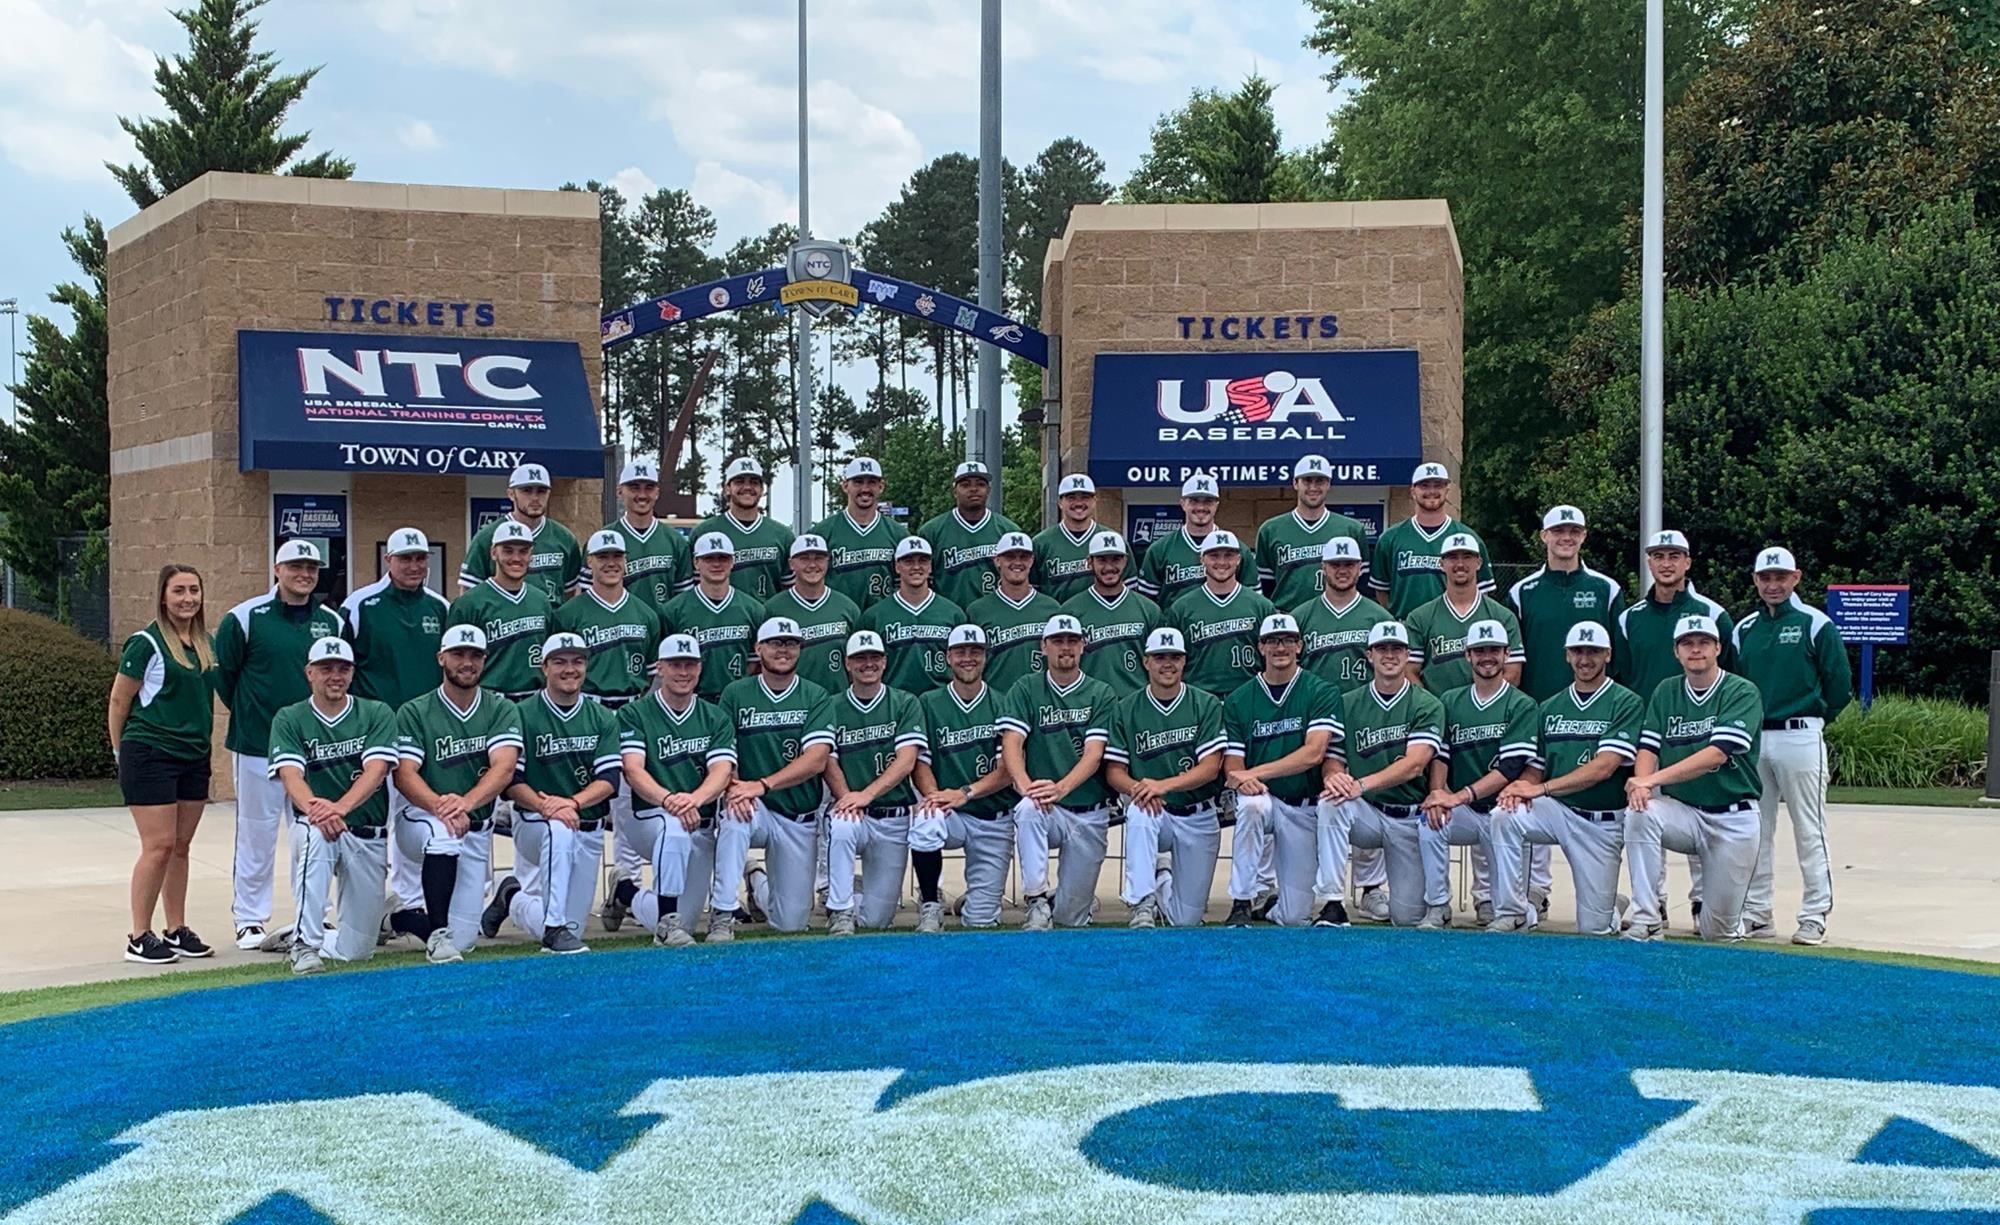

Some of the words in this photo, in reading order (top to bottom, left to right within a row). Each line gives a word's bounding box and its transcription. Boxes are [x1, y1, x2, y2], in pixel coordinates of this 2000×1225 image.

[807, 260, 831, 269] NTC
[325, 298, 495, 327] TICKETS
[1178, 315, 1339, 340] TICKETS
[297, 347, 543, 401] NTC
[1157, 371, 1346, 423] USA
[304, 399, 332, 407] USA
[335, 401, 405, 409] BASEBALL
[304, 407, 388, 417] NATIONAL
[390, 409, 466, 420] TRAINING
[470, 412, 545, 422] COMPLEX
[1158, 426, 1346, 442] BASEBALL
[741, 462, 753, 470] M
[860, 462, 872, 472] M
[967, 464, 979, 473] M
[1310, 460, 1321, 470] M
[528, 469, 542, 480] M
[635, 466, 648, 476] M
[1128, 466, 1171, 481] OUR
[1426, 467, 1438, 475] M
[1073, 478, 1085, 488] M
[1197, 480, 1209, 491] M
[1561, 510, 1574, 520] M
[509, 526, 522, 536] M
[405, 534, 420, 545] M
[602, 534, 616, 545] M
[710, 539, 723, 549] M
[805, 538, 818, 547] M
[1011, 536, 1024, 546] M
[1103, 536, 1116, 547] M
[1216, 535, 1229, 544] M
[1453, 537, 1465, 546] M
[1661, 534, 1672, 543] M
[297, 545, 311, 555] M
[909, 540, 922, 549] M
[1336, 544, 1349, 554] M
[530, 553, 564, 567] HURST
[832, 547, 894, 567] MERCYHURST
[944, 544, 999, 569] MERCYHURS
[1277, 544, 1324, 565] MERCYHU
[1767, 554, 1779, 565] M
[625, 555, 672, 575] ERCYHURST
[982, 572, 996, 592] 2
[778, 622, 792, 633] M
[1059, 619, 1072, 629] M
[1273, 618, 1286, 629] M
[1689, 619, 1701, 629] M
[487, 616, 545, 643] MERCYHURST
[801, 622, 847, 640] RCYHURST
[886, 623, 951, 643] MERCYHURST
[1082, 623, 1144, 645] MERCYHURST
[1190, 617, 1256, 642] MERCYHURST
[1383, 626, 1396, 636] M
[1480, 627, 1493, 638] M
[1579, 629, 1593, 641] M
[461, 631, 474, 642] M
[583, 625, 647, 646] MERCYHURST
[860, 635, 873, 646] M
[964, 630, 977, 641] M
[1161, 634, 1174, 645] M
[561, 637, 573, 648] M
[677, 641, 691, 652] M
[1305, 630, 1369, 654] MERCYHURST
[1431, 635, 1467, 656] MERCY
[326, 643, 340, 654] M
[829, 650, 841, 671] 9
[925, 650, 946, 672] 19
[1031, 650, 1043, 672] 5
[1124, 650, 1136, 671] 6
[1232, 645, 1255, 668] 10
[628, 653, 645, 674] 8
[728, 654, 741, 676] 4
[1341, 657, 1366, 680] 14
[936, 725, 997, 748] MERCYHURS
[1449, 723, 1509, 744] MERCYHURS
